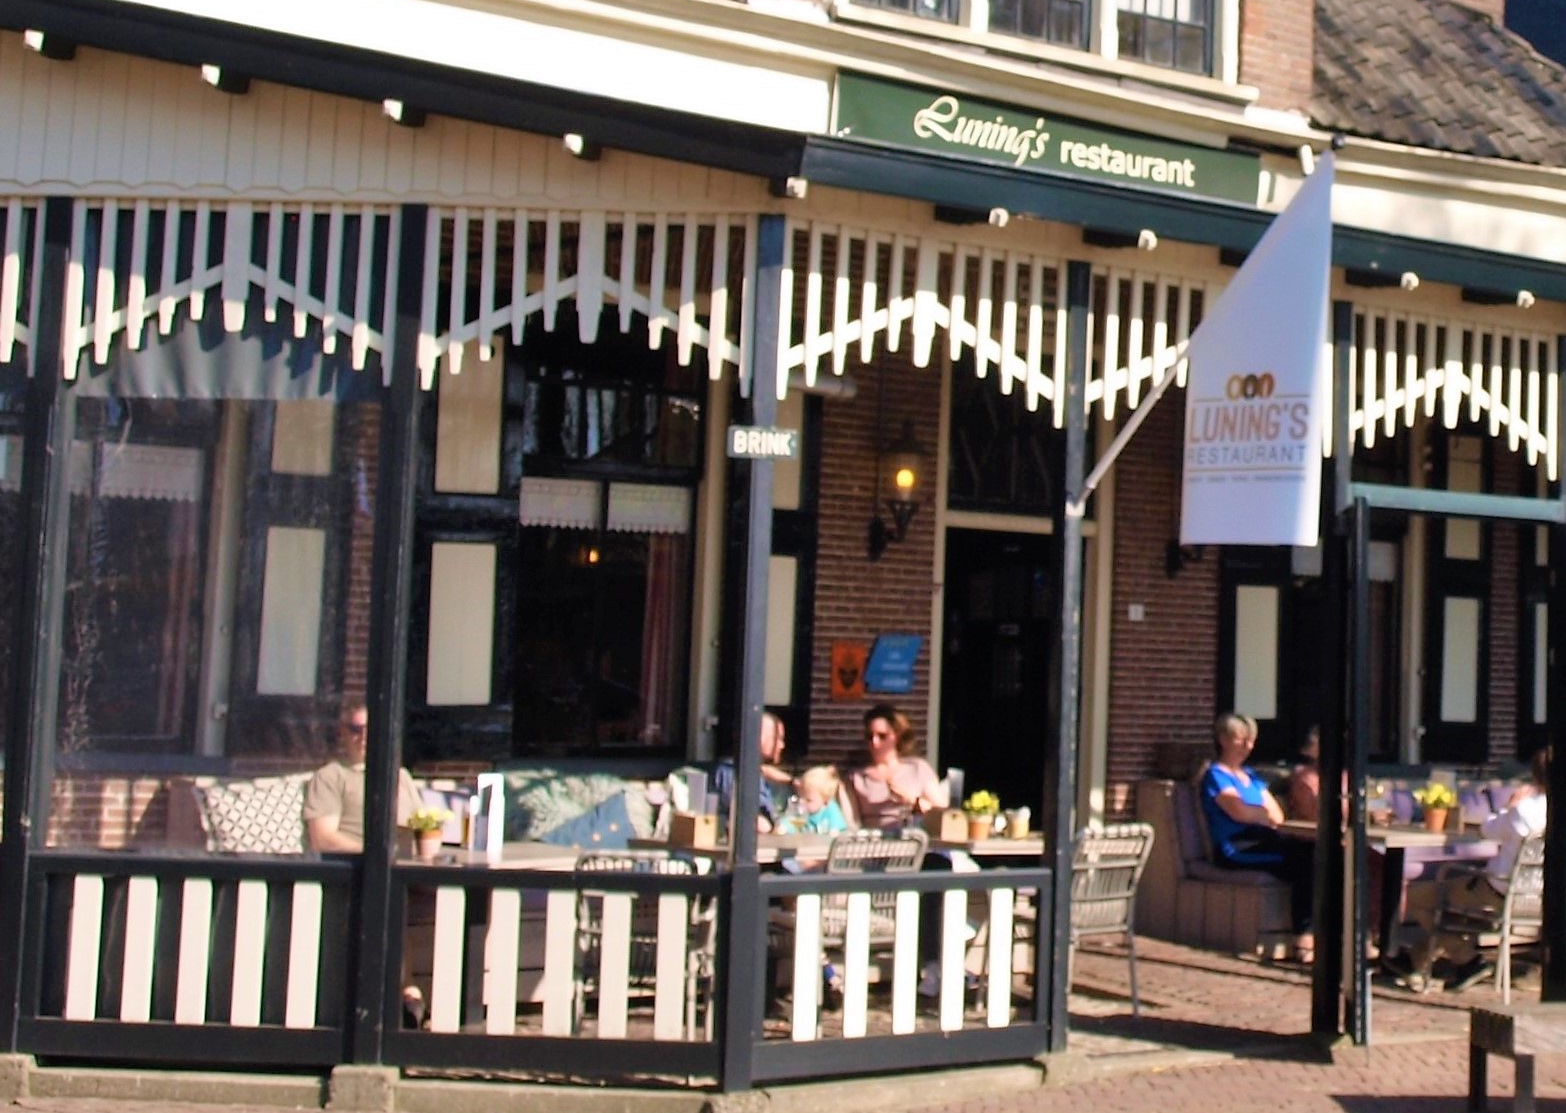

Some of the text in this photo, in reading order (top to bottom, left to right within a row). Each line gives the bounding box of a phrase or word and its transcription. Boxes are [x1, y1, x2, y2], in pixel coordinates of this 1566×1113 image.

[914, 95, 1195, 186] Luning's restaurant
[1190, 403, 1309, 442] LUNING'S
[734, 430, 791, 456] BRINK
[1187, 445, 1306, 464] RESTAURANT
